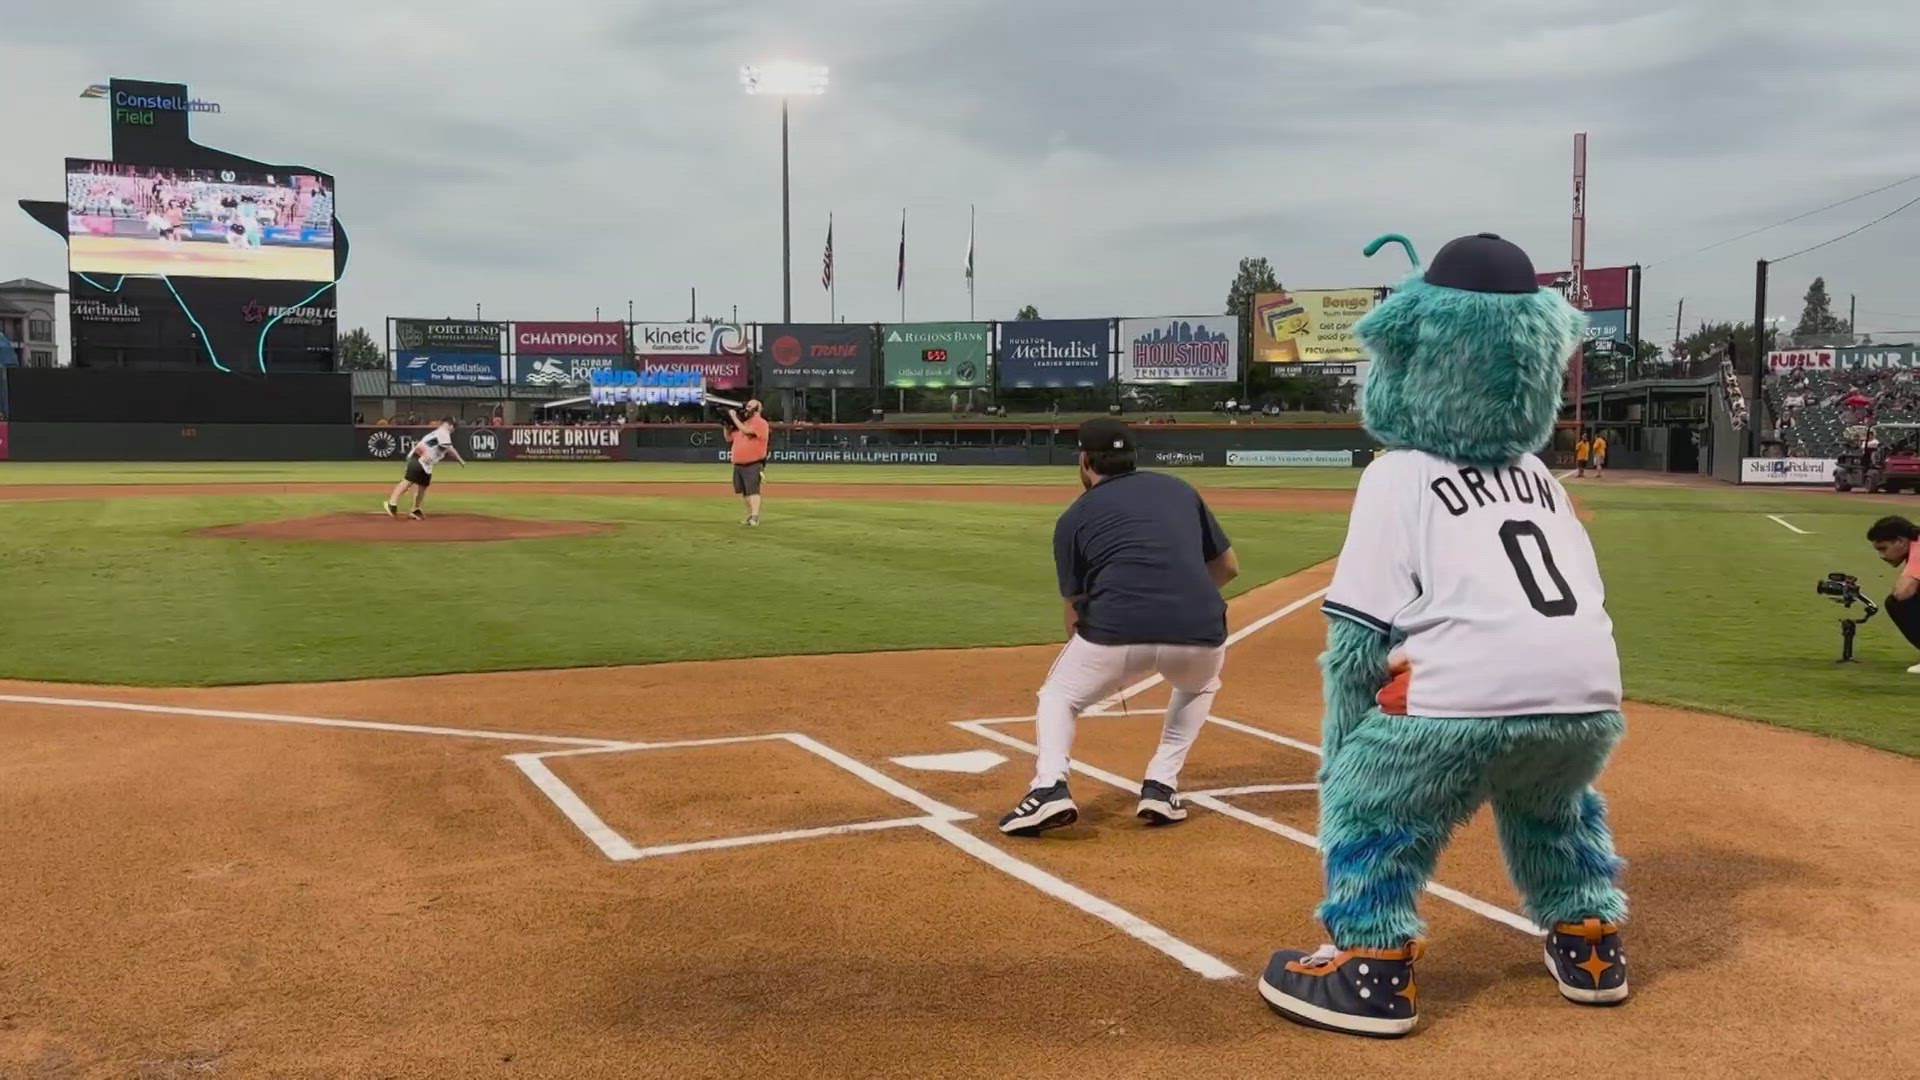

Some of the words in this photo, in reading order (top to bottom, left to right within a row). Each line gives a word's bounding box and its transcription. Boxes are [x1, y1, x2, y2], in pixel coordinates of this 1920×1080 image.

[116, 91, 221, 114] Constellation
[116, 108, 154, 125] Field
[73, 303, 140, 317] Methodist
[1323, 296, 1368, 309] Bongo
[268, 306, 337, 318] REPUBLIC
[428, 325, 462, 335] FORT
[465, 325, 499, 336] BEND
[645, 327, 706, 343] kinetic
[905, 332, 953, 342] REGIONS
[954, 331, 983, 341] BANK
[810, 344, 857, 357] TRANE
[1011, 341, 1098, 359] Methodist
[1133, 341, 1229, 368] HOUSTON
[509, 429, 560, 446] JUSTICE
[564, 429, 619, 446] DRIVEN
[774, 450, 841, 462] FURNITURE
[843, 450, 898, 462] BULLPEN
[901, 450, 938, 463] PATIO
[1750, 461, 1775, 472] Shell
[1788, 461, 1824, 473] Federal
[1431, 466, 1556, 516] ORION
[1498, 519, 1578, 617] 0
